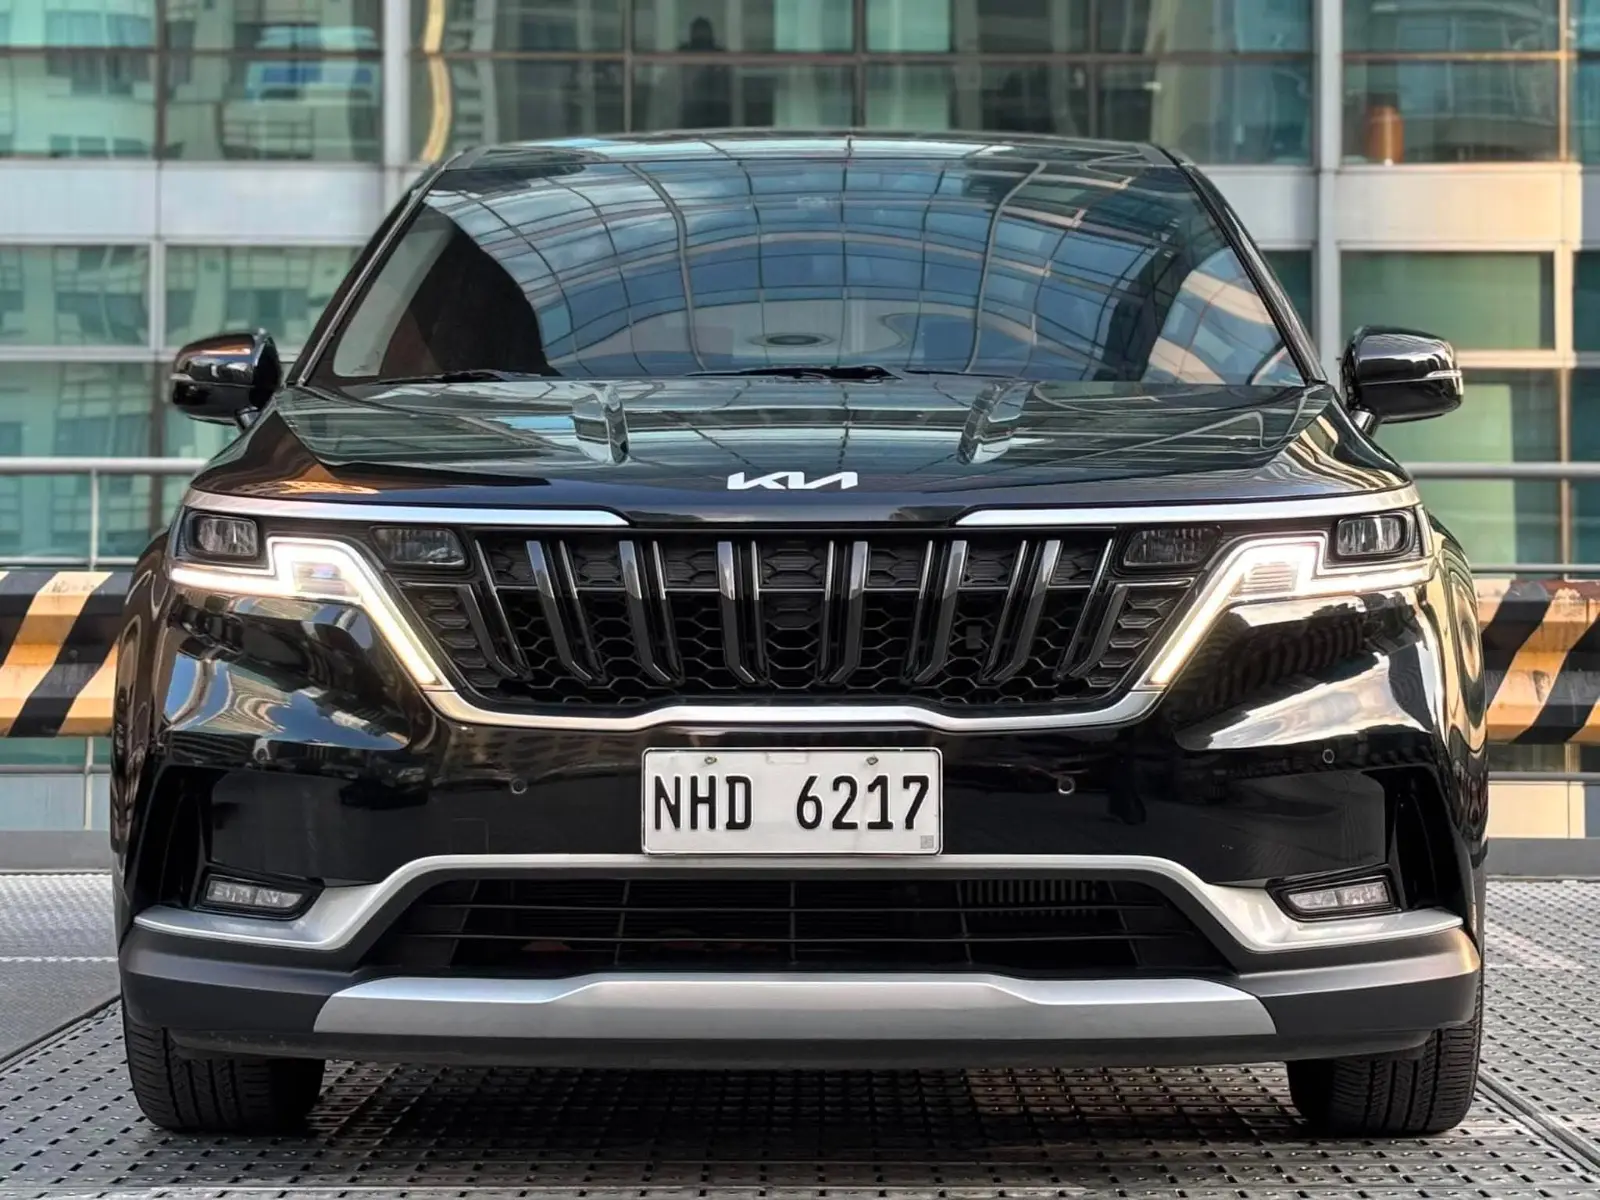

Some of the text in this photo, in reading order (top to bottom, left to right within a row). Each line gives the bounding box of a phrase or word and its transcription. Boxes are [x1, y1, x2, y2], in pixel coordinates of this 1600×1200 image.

[727, 471, 858, 490] KIA
[654, 775, 930, 830] NHD 6217
